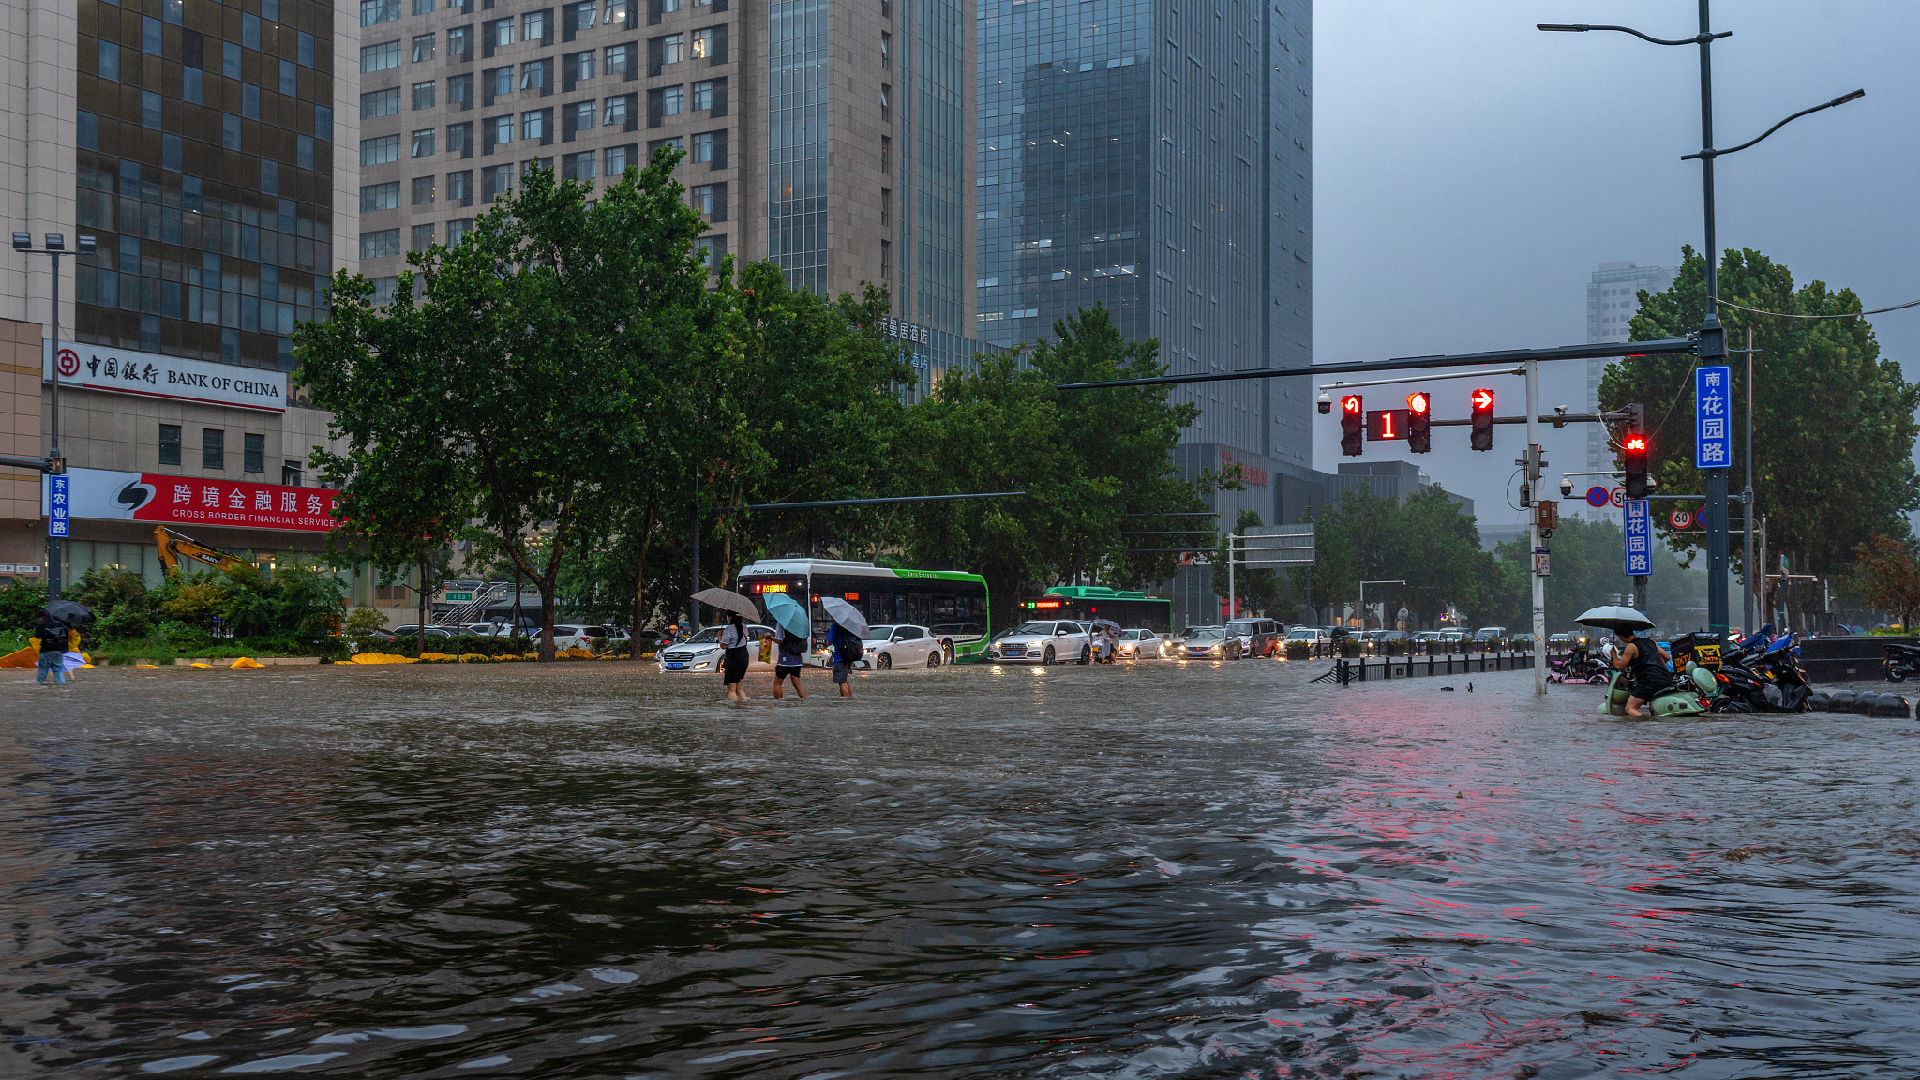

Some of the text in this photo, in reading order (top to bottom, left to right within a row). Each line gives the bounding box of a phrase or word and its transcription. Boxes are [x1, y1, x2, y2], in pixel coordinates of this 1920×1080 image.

[168, 370, 279, 397] BANK OF CHINA
[1382, 412, 1395, 438] 1
[1702, 372, 1724, 463] 南花园路
[53, 479, 66, 534] 东农业路
[1614, 492, 1628, 504] 50
[172, 509, 205, 518] CROSS
[208, 511, 246, 521] BORDER
[248, 514, 295, 525] FINANCIAL
[298, 517, 335, 527] SERVICE
[1674, 512, 1688, 523] 60
